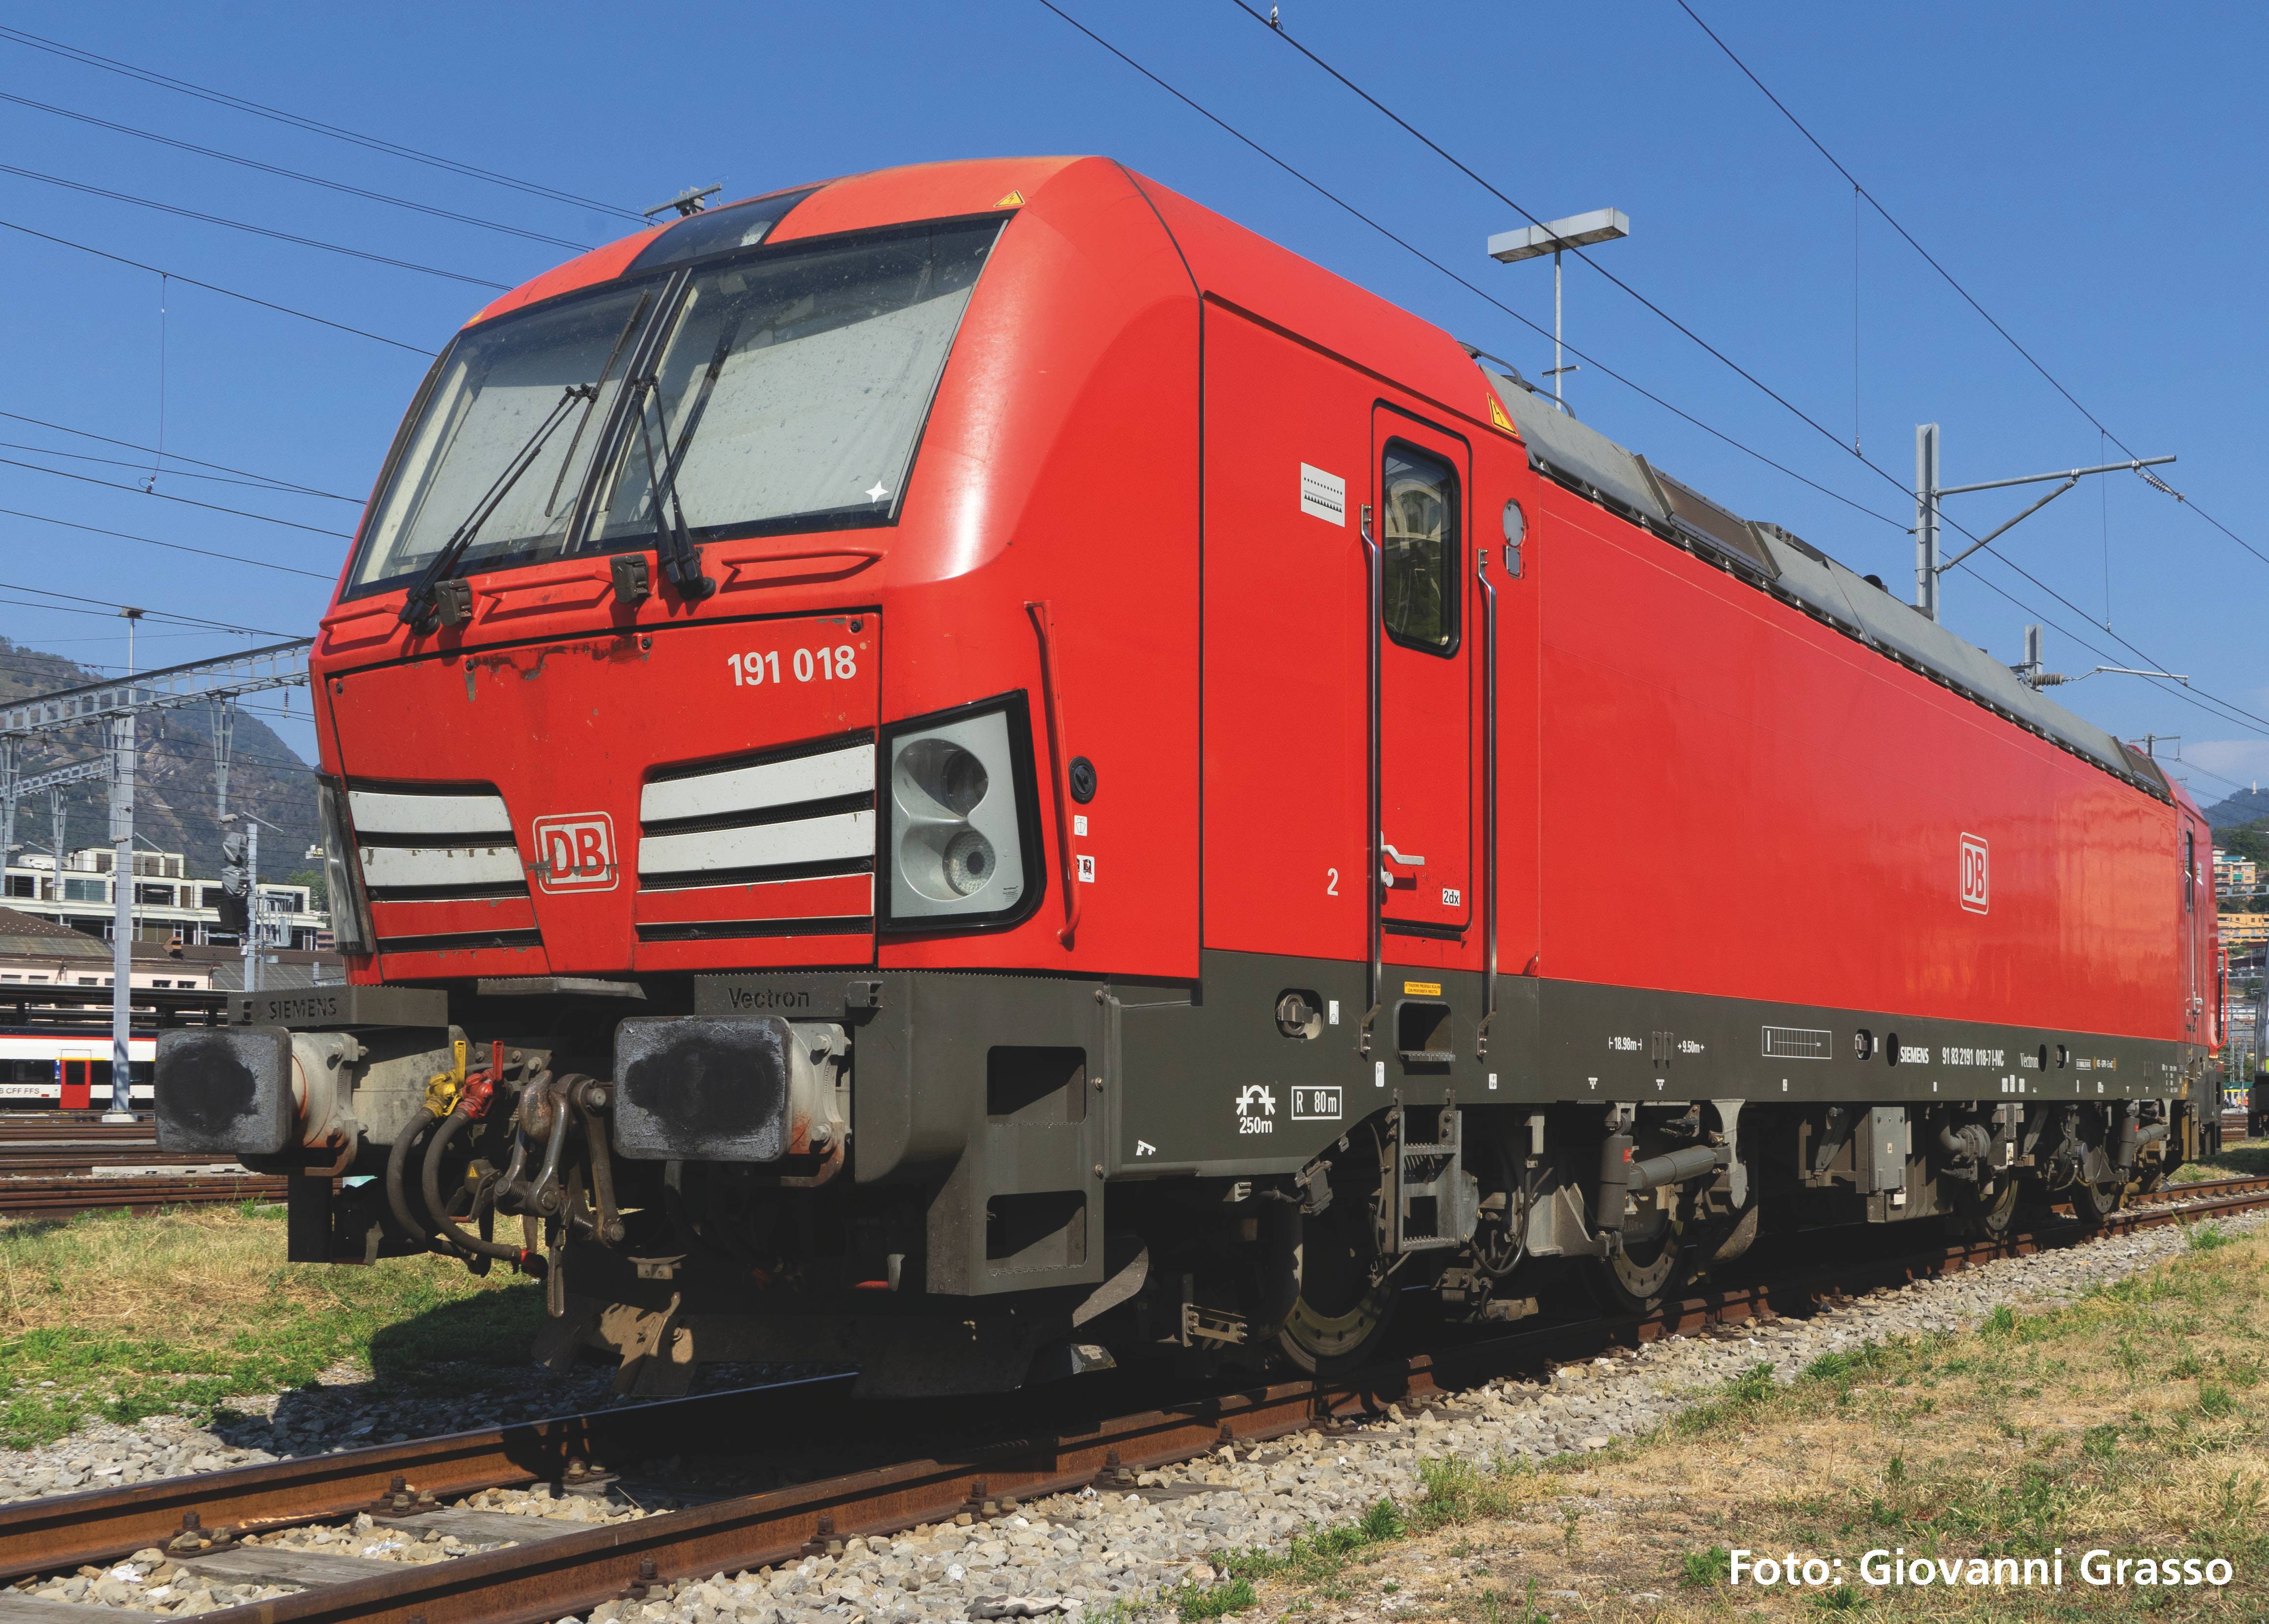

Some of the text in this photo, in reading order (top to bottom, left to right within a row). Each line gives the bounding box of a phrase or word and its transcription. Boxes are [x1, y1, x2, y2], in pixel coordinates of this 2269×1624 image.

[727, 645, 857, 686] 191 018
[543, 826, 607, 881] DB
[1327, 867, 1338, 896] 2
[1964, 847, 1985, 900] DB
[1443, 890, 1460, 905] 2dx
[269, 997, 337, 1020] SIEMENS
[728, 987, 809, 1008] Vectron
[1900, 1046, 1929, 1064] SIEMENS
[1942, 1047, 1950, 1065] 91
[1951, 1047, 1958, 1065] 83
[1959, 1048, 1973, 1065] 2191
[1976, 1049, 1991, 1066] 018-7
[1296, 1091, 1303, 1113] R
[1239, 1116, 1273, 1134] 250m
